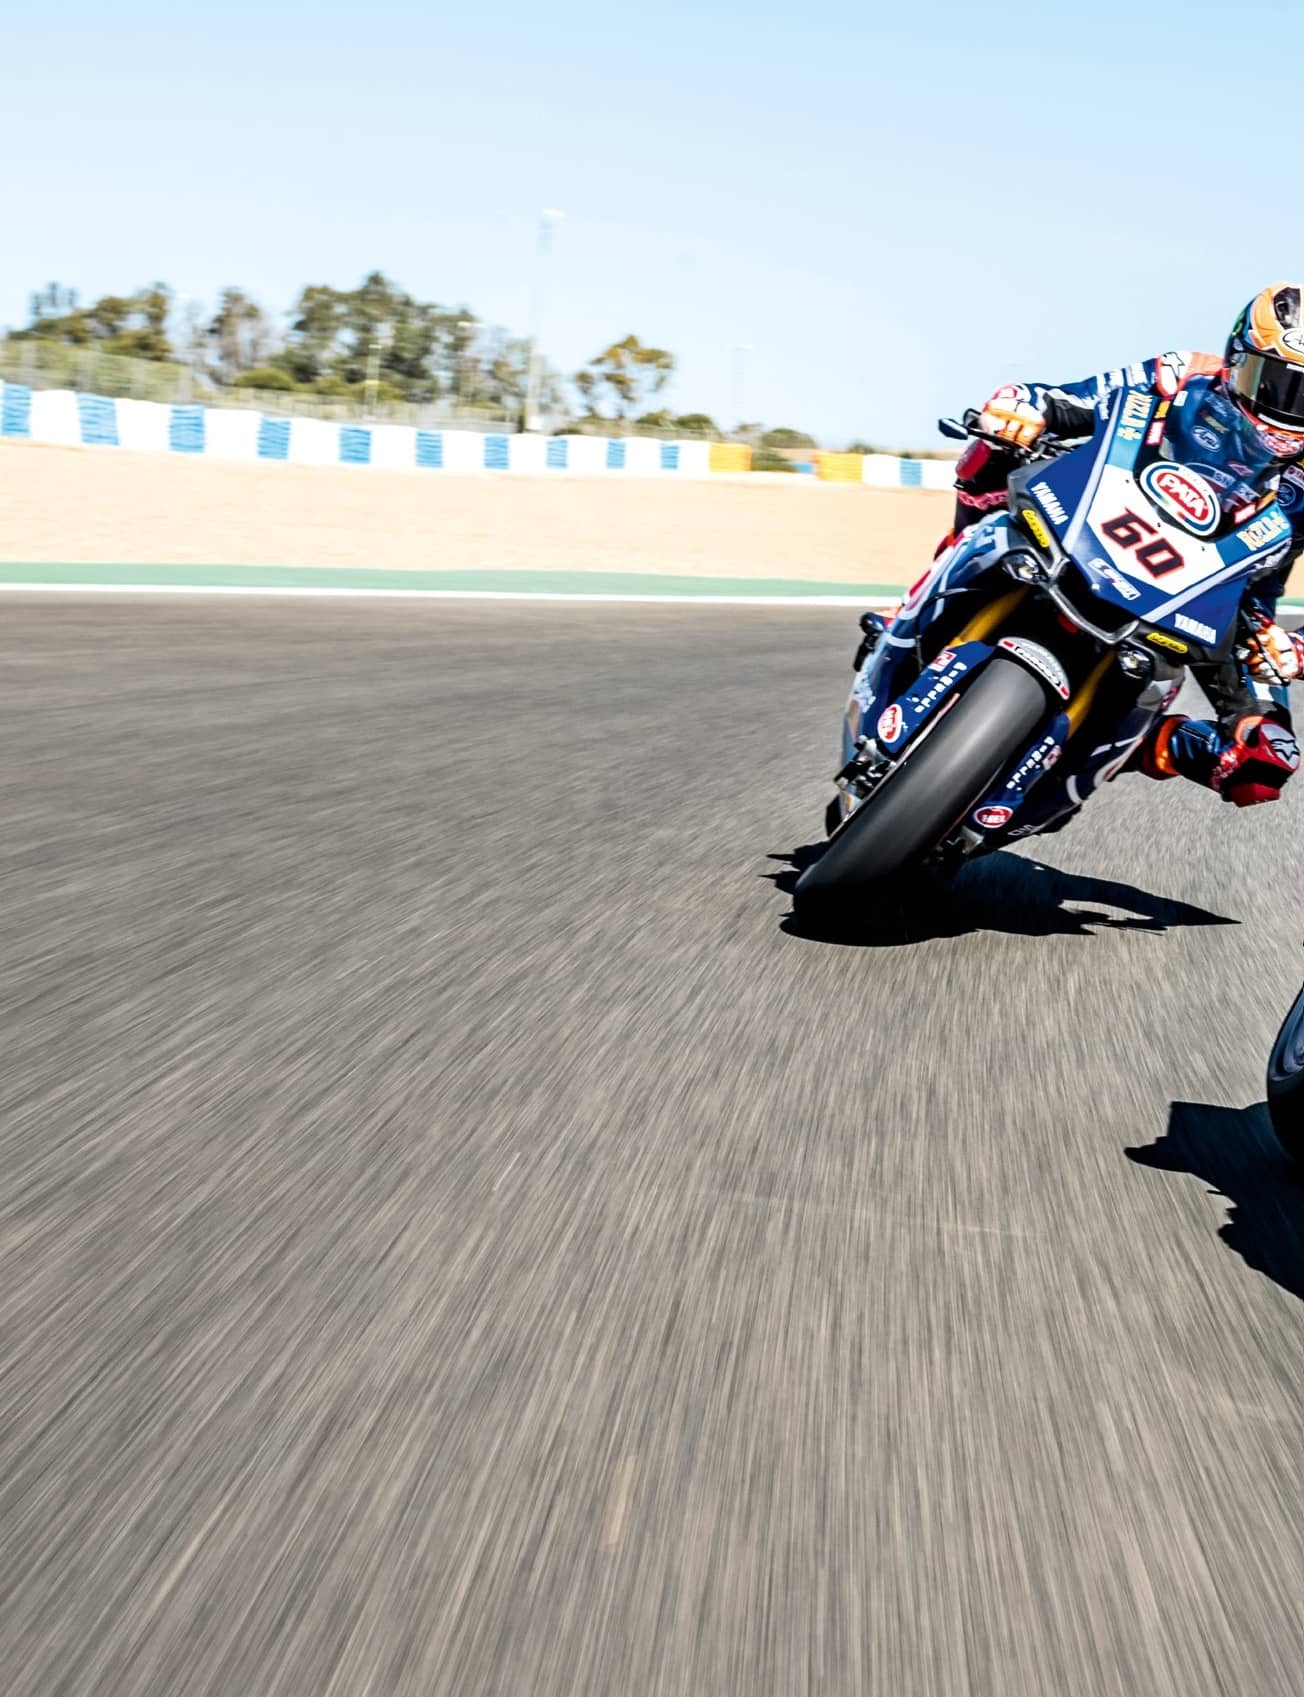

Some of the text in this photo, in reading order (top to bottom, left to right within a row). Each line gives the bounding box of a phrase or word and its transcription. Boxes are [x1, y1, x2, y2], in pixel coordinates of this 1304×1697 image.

[1031, 482, 1069, 525] YAMAHA
[1158, 473, 1206, 519] PATA
[1101, 507, 1185, 580] 60
